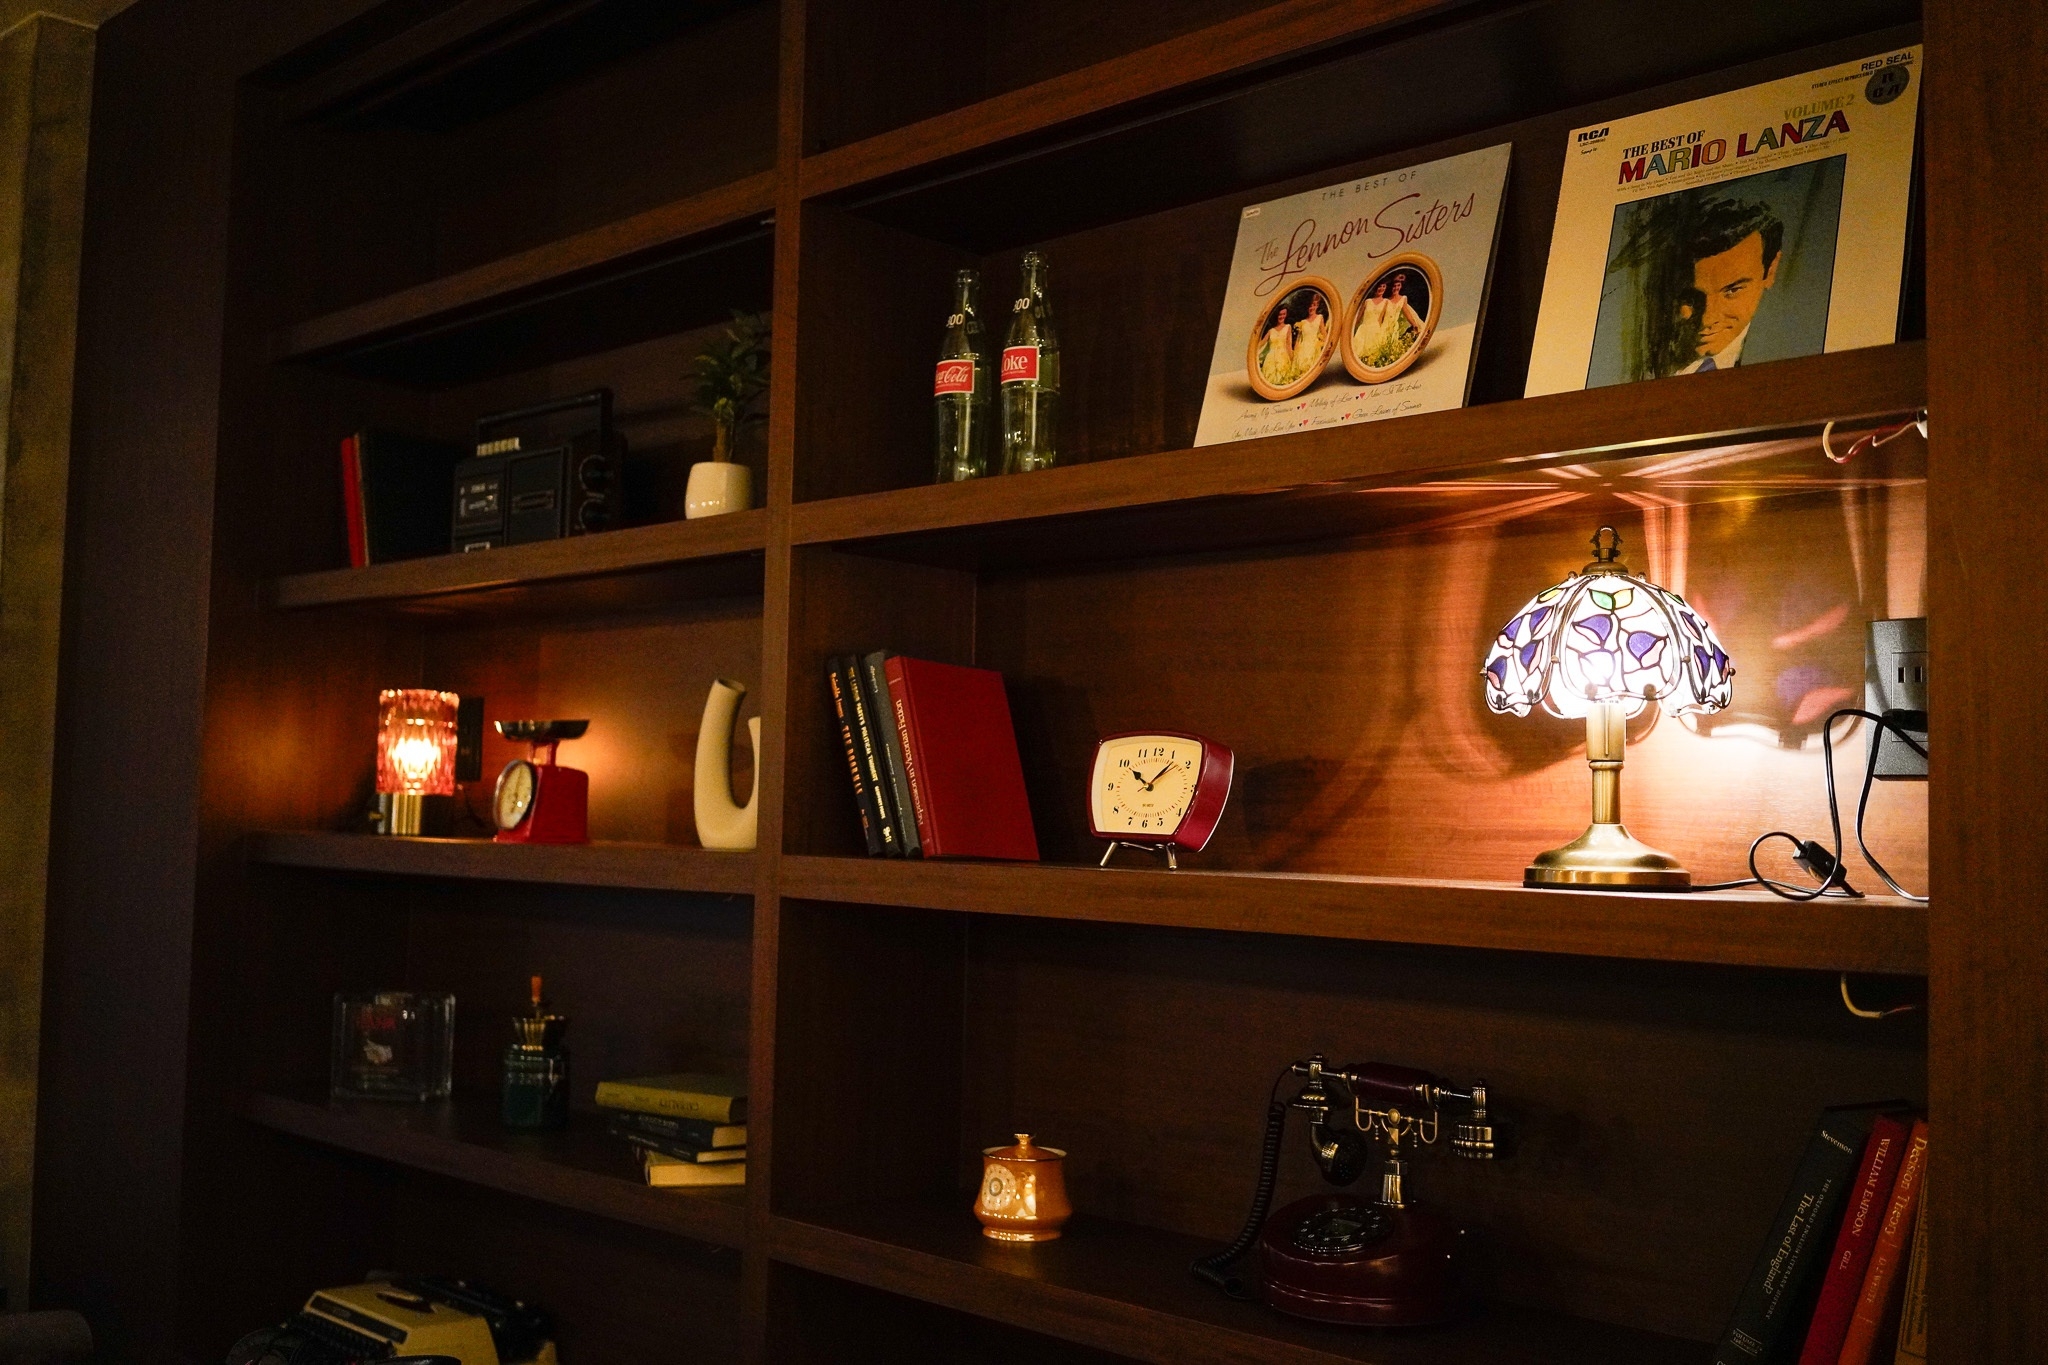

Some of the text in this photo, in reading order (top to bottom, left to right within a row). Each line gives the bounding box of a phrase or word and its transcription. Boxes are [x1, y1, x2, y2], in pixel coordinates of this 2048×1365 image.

[1861, 58, 1883, 72] RED
[1886, 51, 1914, 66] SEAL
[1784, 93, 1856, 120] VOLUME 2
[1577, 127, 1610, 142] RCA
[1618, 138, 1727, 185] MARIO
[1736, 110, 1850, 158] LANZA
[1622, 129, 1706, 160] THE BEST OF
[1322, 170, 1418, 200] THE BEST OF
[1254, 192, 1475, 297] The Lennon Sisters
[1138, 749, 1149, 758] 11
[1153, 747, 1164, 757] 12
[1171, 750, 1176, 759] 1
[896, 698, 924, 825] Repression in Victorian Fiction
[1119, 759, 1130, 768] 10
[1185, 760, 1192, 769] 2
[1107, 782, 1114, 791] 9
[1112, 806, 1120, 814] 8
[1176, 807, 1183, 817] 4
[1127, 817, 1134, 826] 7
[1141, 819, 1148, 828] 6
[1157, 817, 1164, 827] 5
[1901, 1136, 1928, 1190] Decision
[1852, 1138, 1891, 1237] WILLIAM EMPSON
[1884, 1194, 1910, 1236] Theory
[1762, 1192, 1814, 1295] The Last of England?
[1840, 1250, 1851, 1271] GILL
